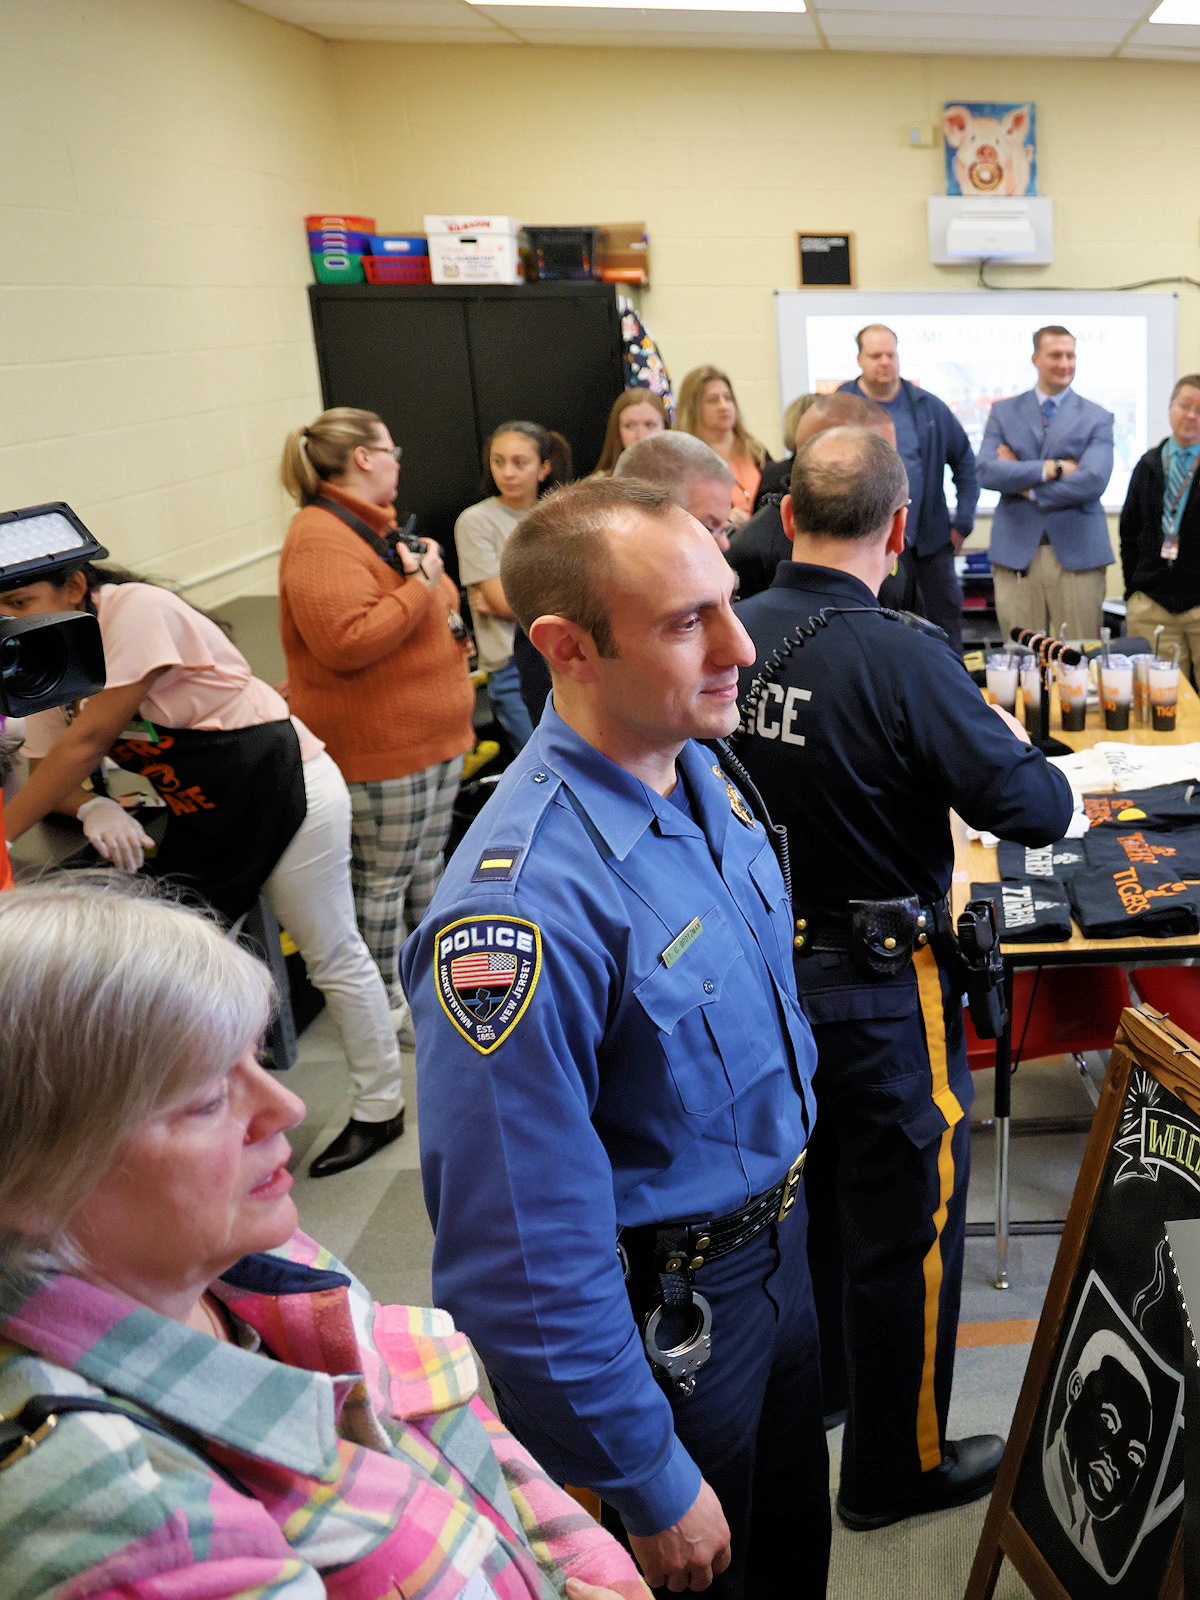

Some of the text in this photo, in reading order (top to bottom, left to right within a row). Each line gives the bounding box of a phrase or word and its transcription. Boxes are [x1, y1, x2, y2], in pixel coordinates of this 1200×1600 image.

[1076, 329, 1110, 345] AFE
[1113, 867, 1152, 915] TIGERS
[440, 925, 533, 960] POLICE
[440, 964, 474, 1029] HACKETTSTOWN
[499, 959, 532, 1023] NEW JERSEY
